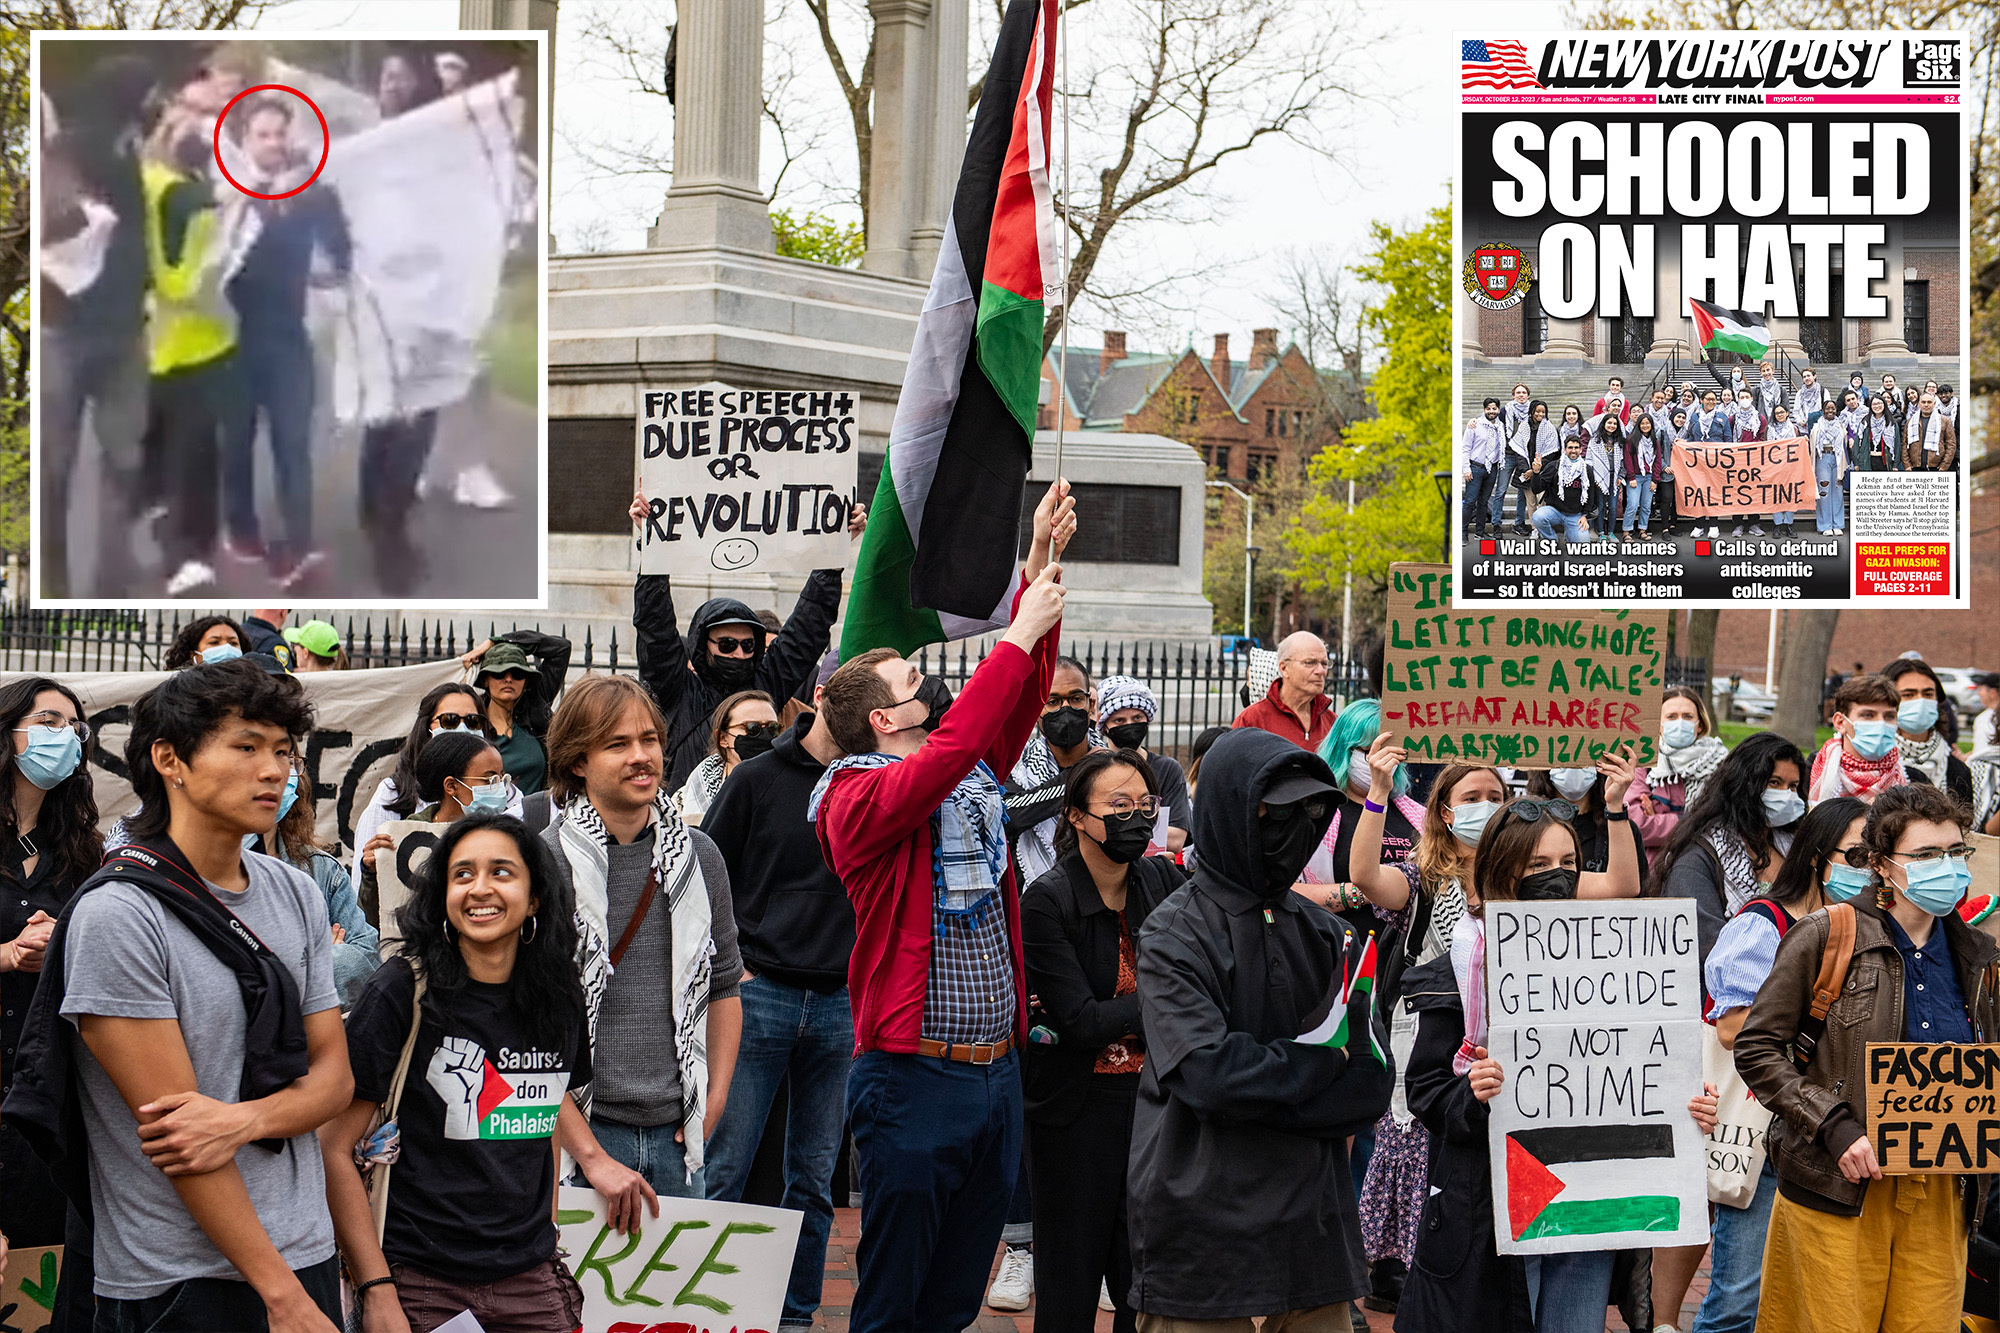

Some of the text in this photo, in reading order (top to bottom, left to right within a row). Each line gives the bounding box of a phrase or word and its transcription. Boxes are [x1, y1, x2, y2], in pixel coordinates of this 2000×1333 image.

[644, 390, 714, 419] FREE
[643, 417, 855, 460] DUE PROCESS
[706, 453, 760, 481] OR
[1685, 443, 1800, 469] JUSTICE
[1726, 468, 1762, 485] FOR
[1683, 481, 1806, 507] PALESTINE
[645, 484, 857, 546] REVOLUTION
[1391, 613, 1448, 650] LET
[1454, 615, 1496, 648] IT
[1505, 618, 1587, 649] BRING
[1386, 655, 1442, 692] LET
[1447, 655, 1494, 690] IT
[1501, 655, 1540, 688] BE
[1548, 659, 1570, 695] A
[119, 848, 159, 867] Canon
[1384, 849, 1394, 859] A
[229, 919, 260, 951] Canon
[1496, 911, 1694, 968] PROTESTING
[1498, 969, 1678, 1015] GENOCIDE
[1513, 1025, 1669, 1063] IS NOT A
[516, 1080, 547, 1099] don
[1514, 1063, 1665, 1119] CRIME
[1875, 1086, 1997, 1118] feeds on
[1877, 1119, 2000, 1169] FEAR
[1705, 1148, 1753, 1176] SON
